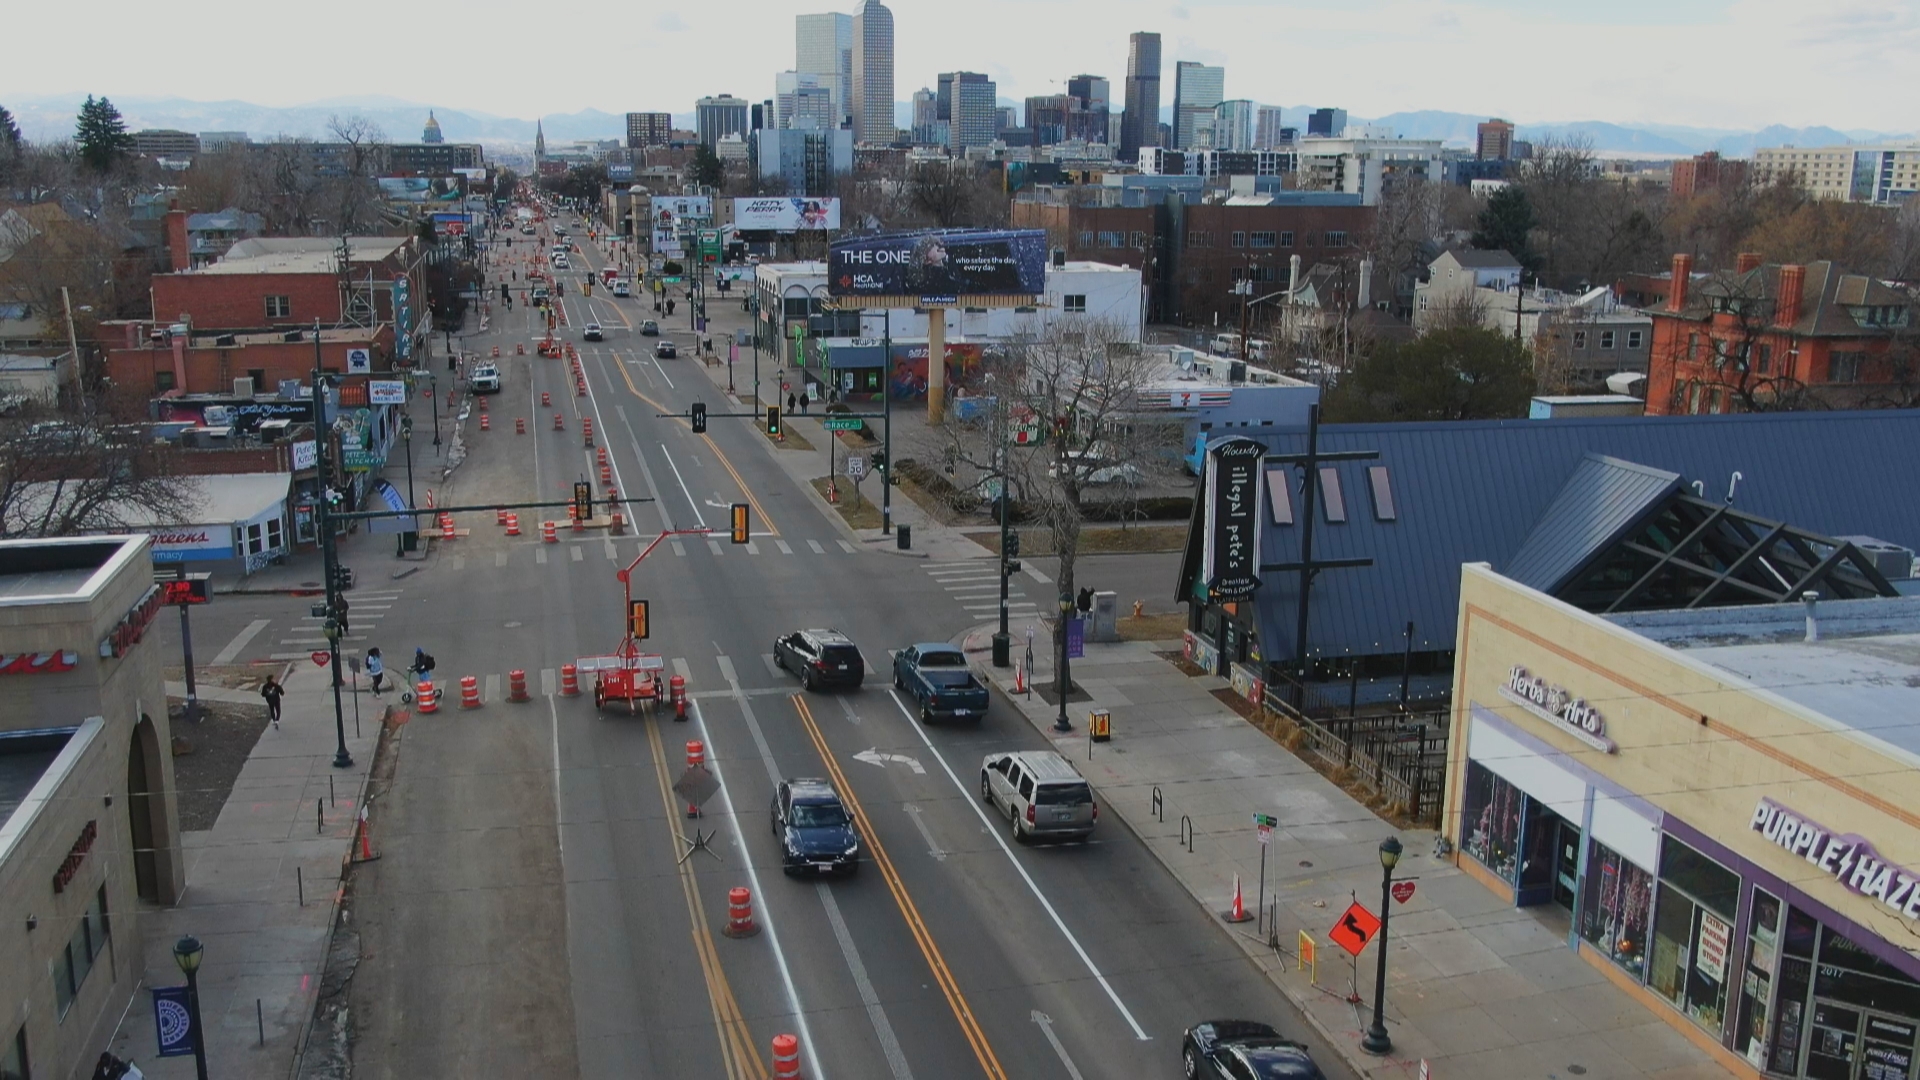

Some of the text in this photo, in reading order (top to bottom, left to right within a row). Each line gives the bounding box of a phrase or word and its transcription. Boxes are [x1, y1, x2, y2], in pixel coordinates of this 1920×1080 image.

[841, 250, 910, 264] THE ONE
[854, 274, 874, 283] HCA
[399, 279, 410, 356] SATIRE
[1221, 444, 1259, 458] Howdy
[850, 466, 862, 474] 30
[1226, 466, 1248, 568] illegal pete's
[149, 531, 210, 547] greens
[153, 551, 183, 560] rmacy
[1509, 666, 1544, 704] Herbs
[1564, 701, 1596, 733] Arts
[1749, 801, 1920, 920] PURPLE HAZE
[1706, 915, 1724, 932] EXTRA
[1702, 925, 1727, 947] PARKING
[1702, 936, 1724, 956] BEHIND
[1702, 949, 1721, 968] STORE
[1820, 966, 1844, 978] 2017
